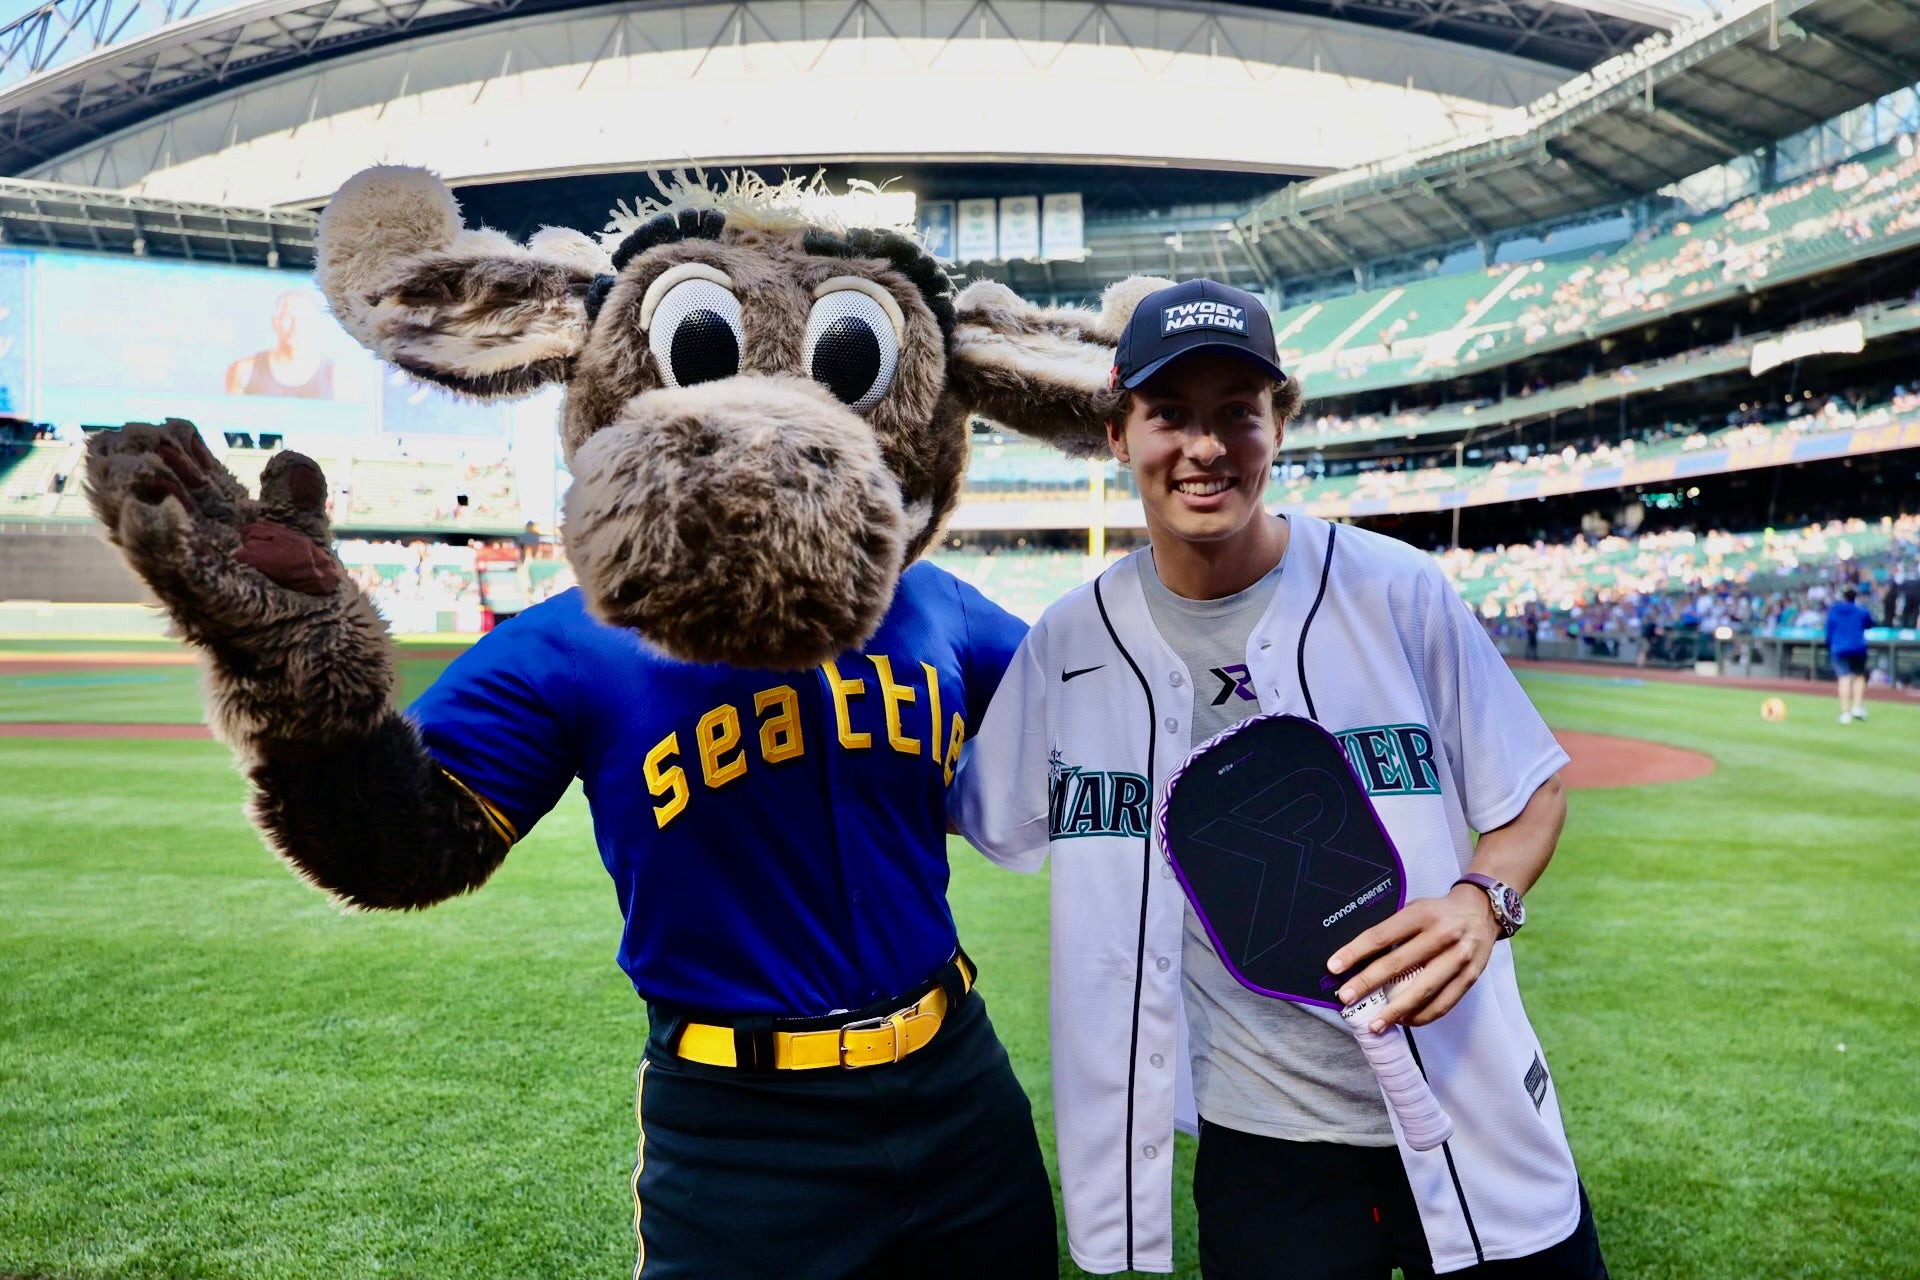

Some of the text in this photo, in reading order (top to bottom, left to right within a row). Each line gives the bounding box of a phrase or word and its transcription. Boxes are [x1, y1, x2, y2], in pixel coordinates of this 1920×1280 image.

[1165, 302, 1242, 319] TWOEY
[1165, 313, 1244, 331] NATION
[643, 654, 965, 829] seattle
[1334, 723, 1442, 796] ER
[1322, 901, 1358, 927] CONNOR
[1356, 878, 1393, 905] GARNETT
